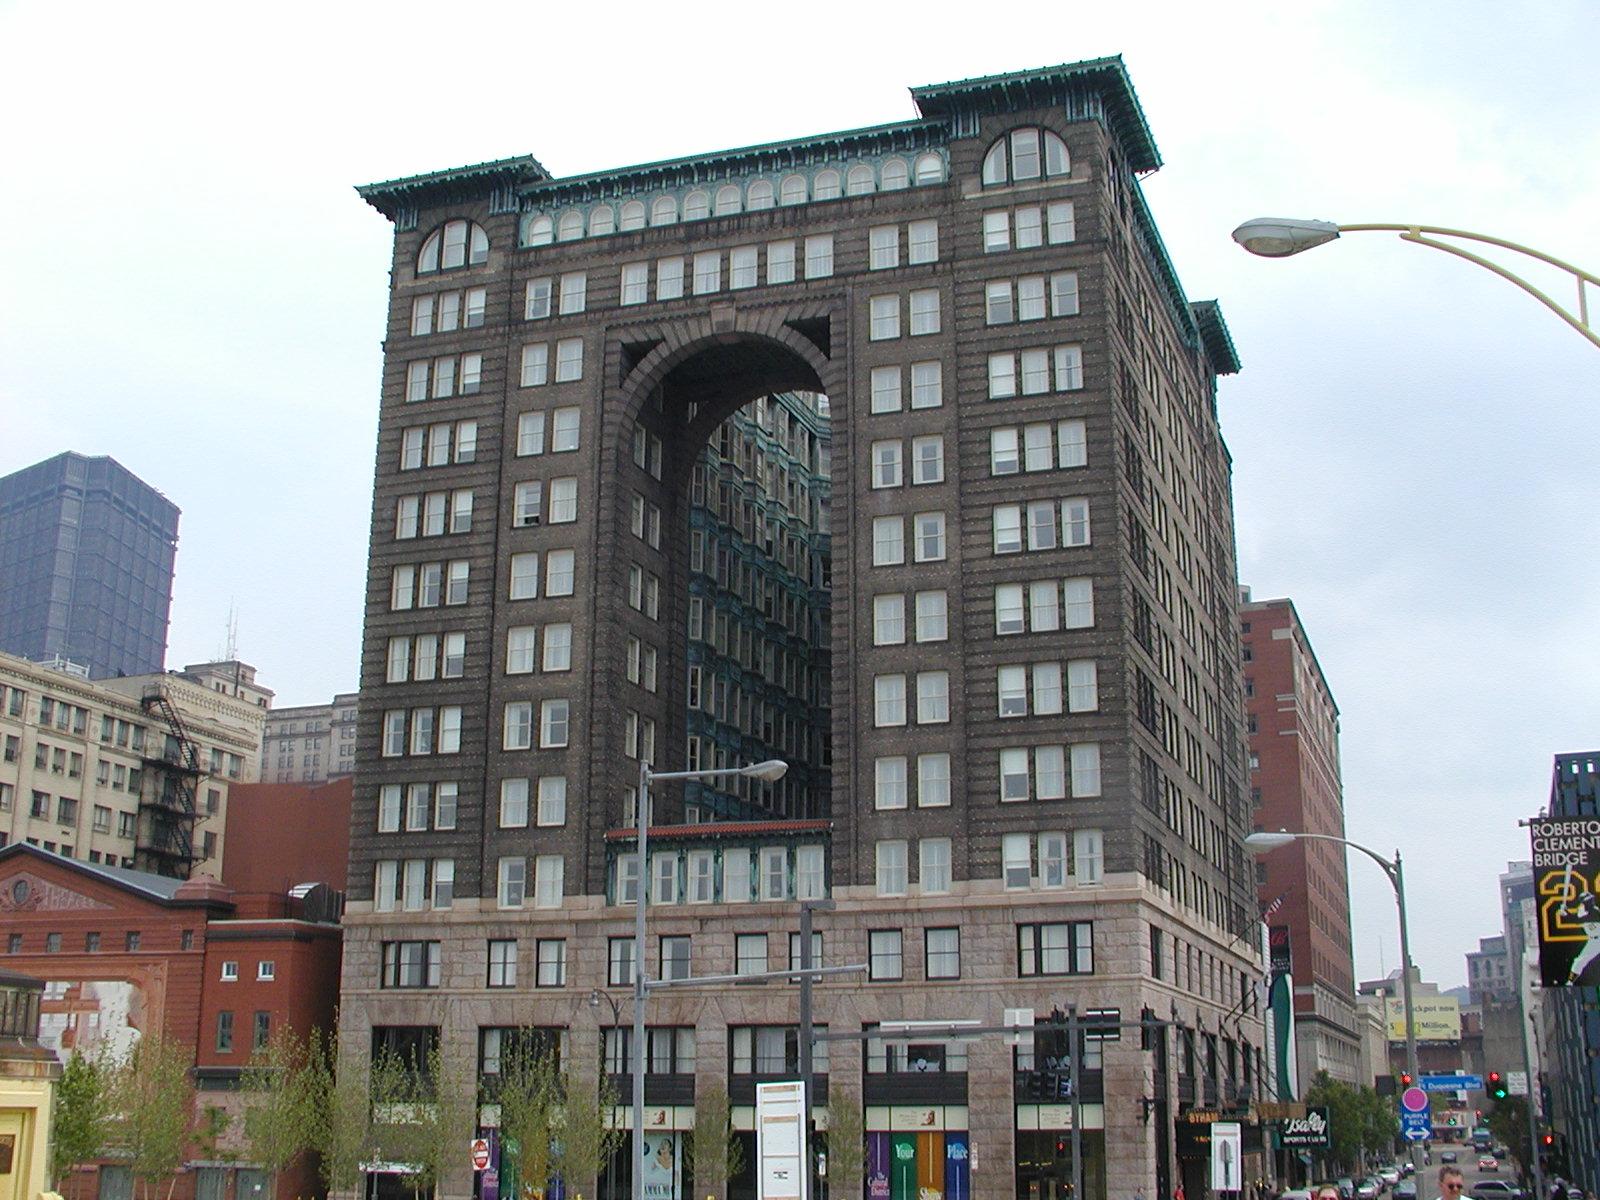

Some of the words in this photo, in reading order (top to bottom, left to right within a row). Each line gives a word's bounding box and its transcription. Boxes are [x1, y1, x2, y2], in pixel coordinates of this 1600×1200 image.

[1532, 821, 1600, 837] ROBERTO
[1534, 837, 1600, 852] CLEMENT
[1535, 852, 1588, 867] BRIDGE
[1540, 870, 1600, 942] 2
[1415, 1005, 1437, 1013] ckpot
[1403, 1112, 1428, 1120] PURPLE
[895, 1143, 915, 1159] Your
[947, 1144, 969, 1159] Place
